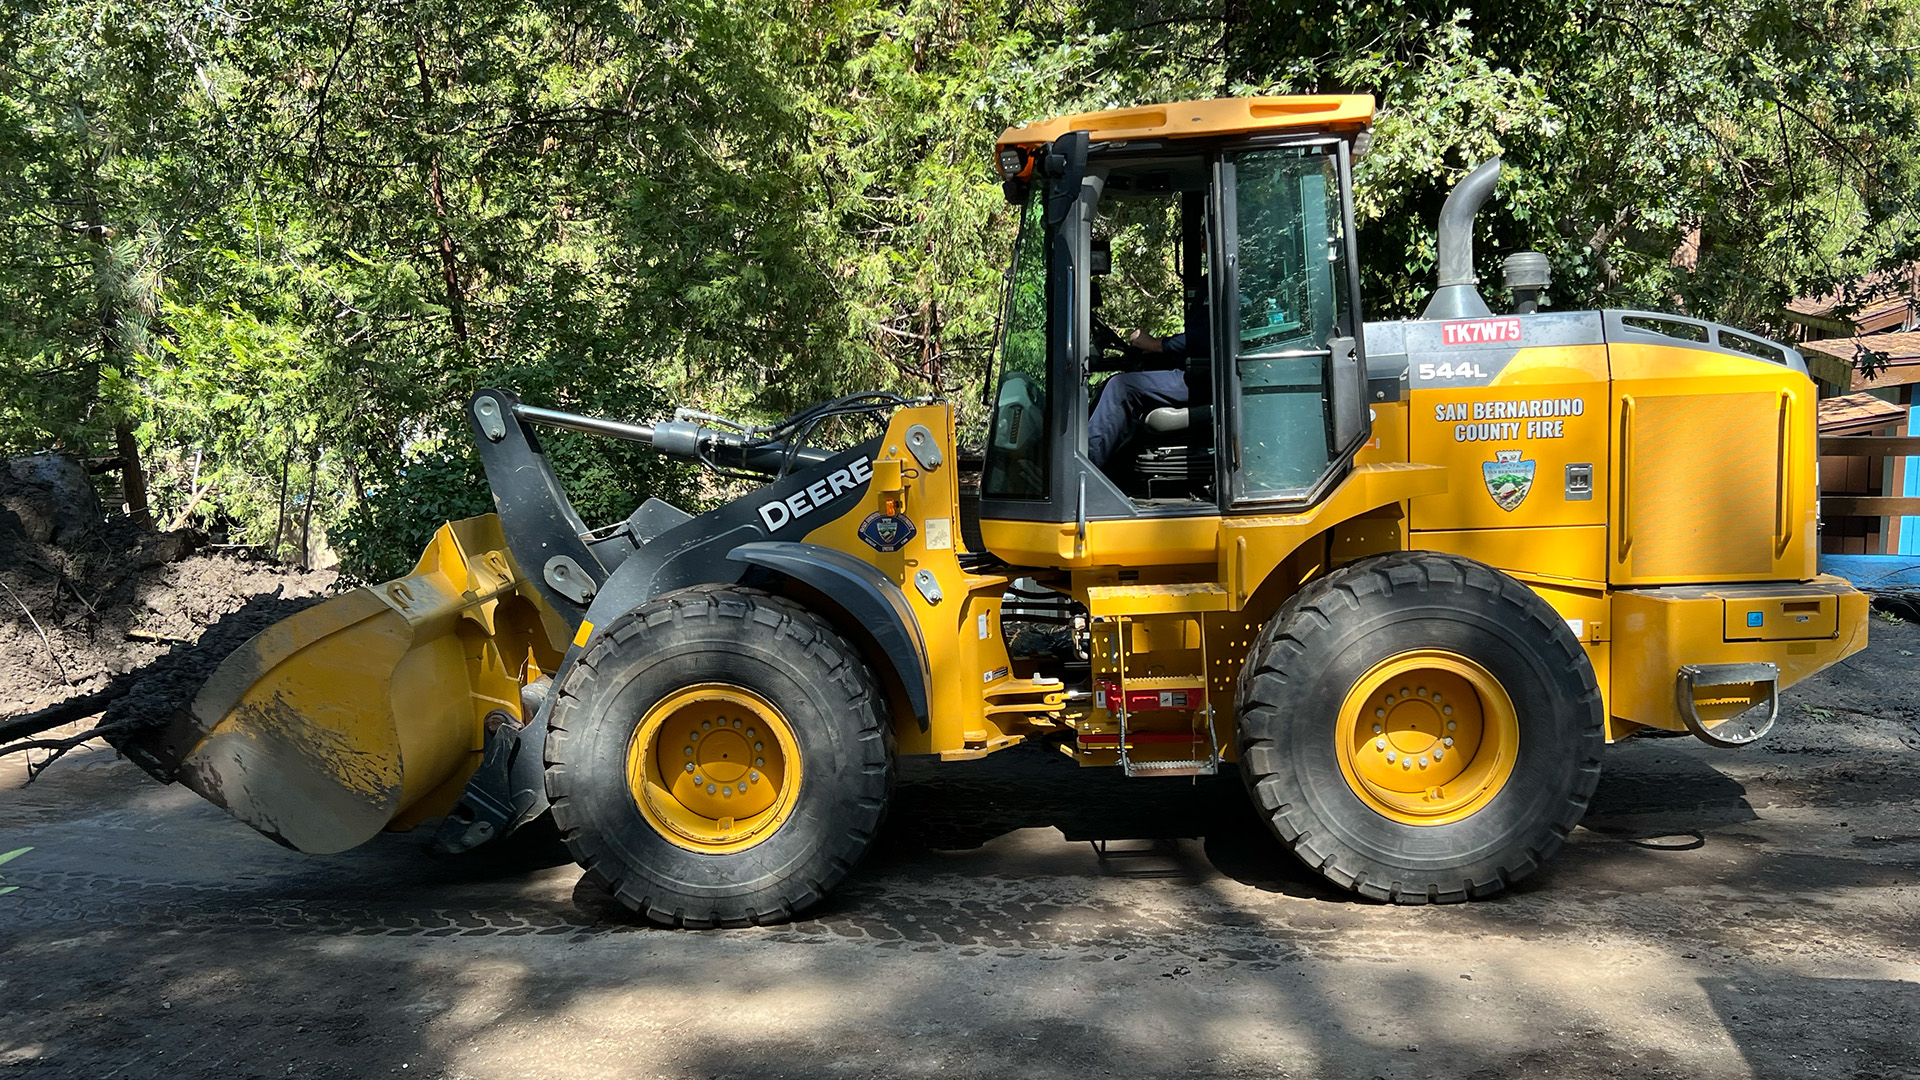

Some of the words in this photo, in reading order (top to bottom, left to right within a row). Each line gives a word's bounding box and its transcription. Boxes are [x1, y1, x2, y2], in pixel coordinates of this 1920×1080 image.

[1444, 320, 1520, 343] TK7W75
[1418, 362, 1488, 380] 544L
[1434, 403, 1469, 422] SAN
[1473, 398, 1584, 420] BERNARDINO
[1454, 421, 1521, 442] COUNTY
[1527, 420, 1564, 440] FIRE
[758, 455, 873, 533] DEERE
